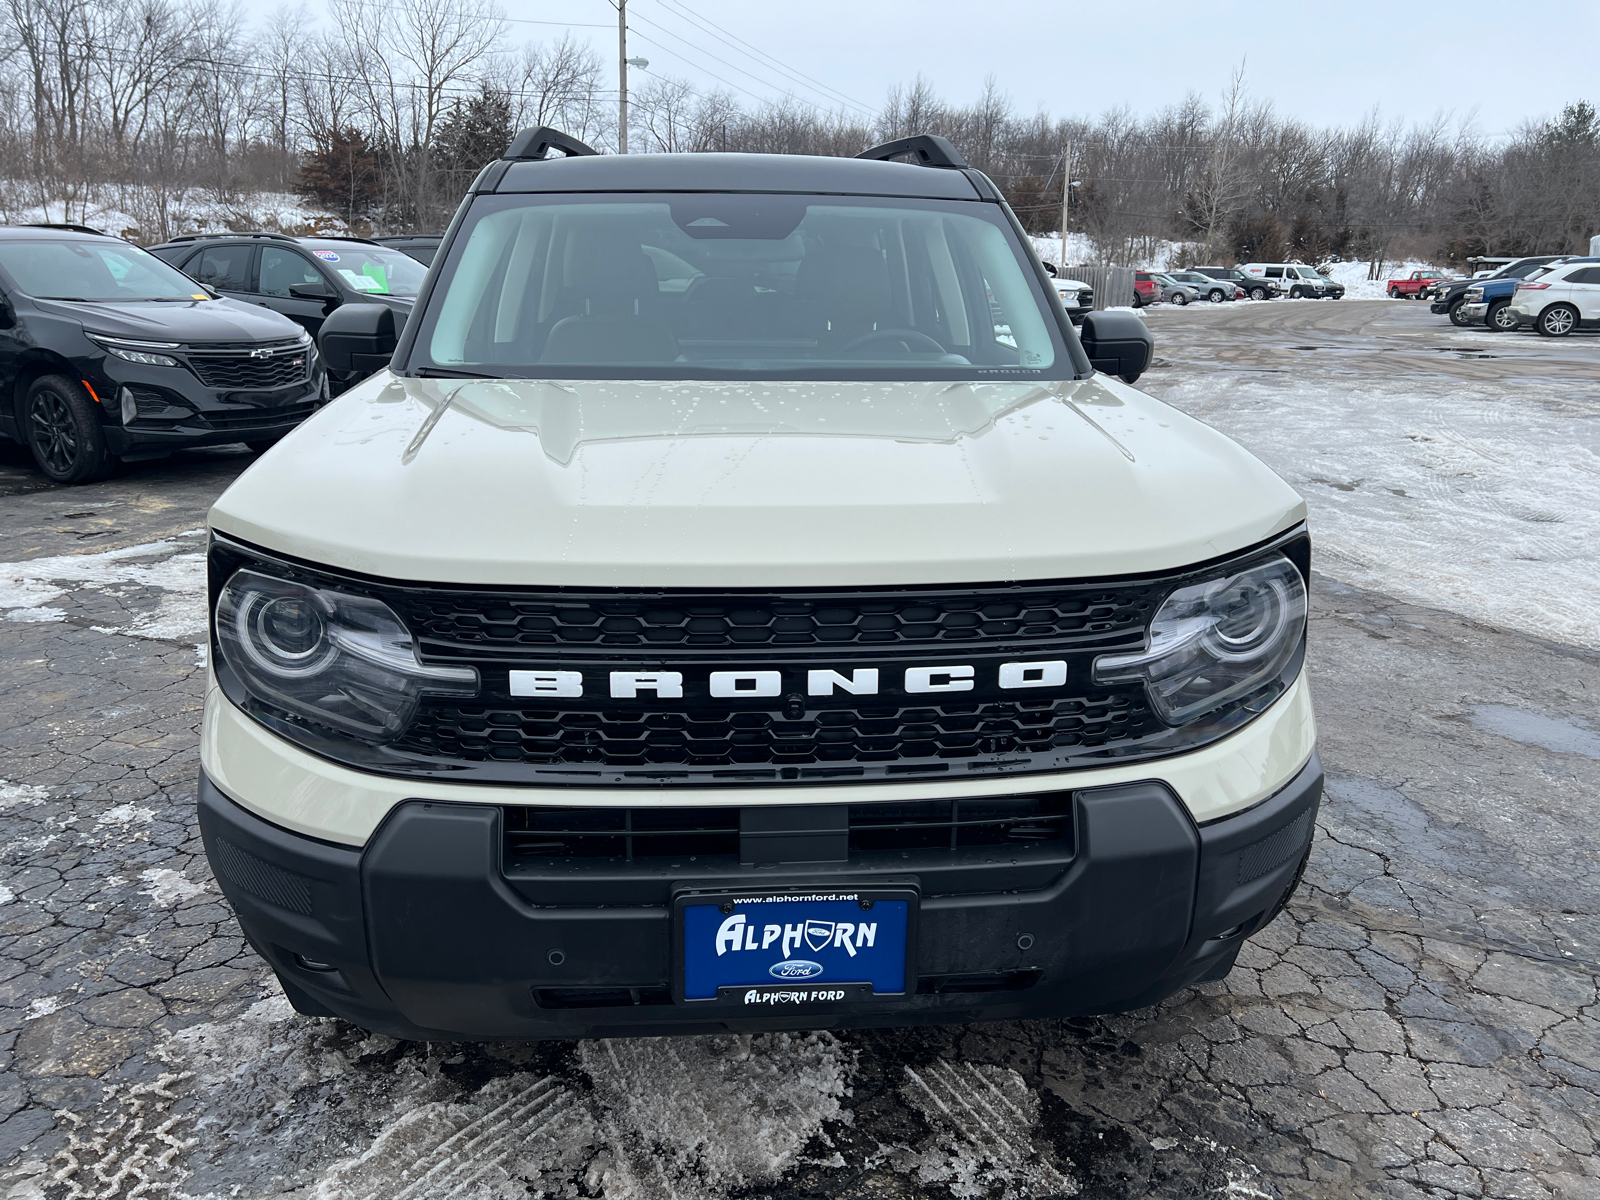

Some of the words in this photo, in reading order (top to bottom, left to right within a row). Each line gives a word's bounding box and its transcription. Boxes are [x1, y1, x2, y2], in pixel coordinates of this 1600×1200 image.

[509, 661, 1068, 699] BRONCO
[733, 893, 859, 904] www.alphornford.net
[781, 963, 812, 976] Ford
[811, 990, 845, 1001] FORD
